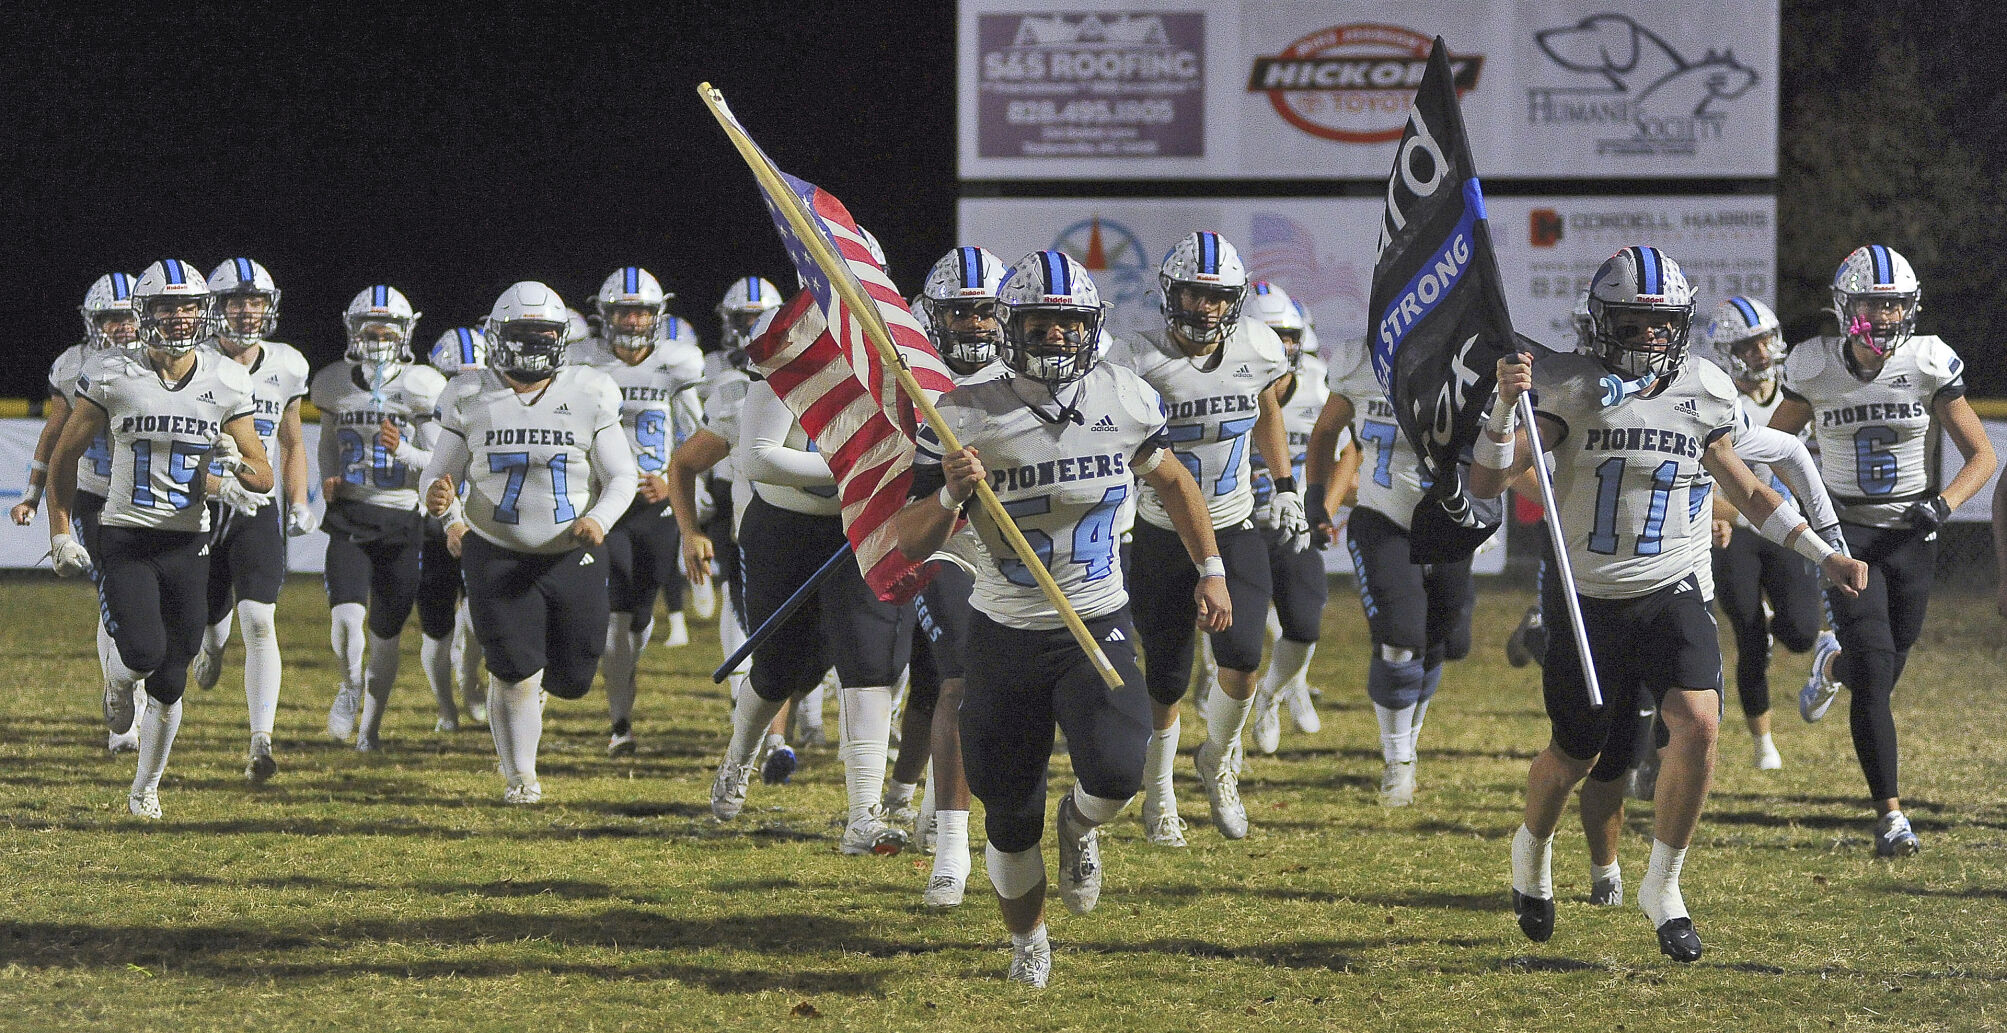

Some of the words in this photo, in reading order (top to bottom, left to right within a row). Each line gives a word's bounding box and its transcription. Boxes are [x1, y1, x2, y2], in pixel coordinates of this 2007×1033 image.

[1051, 51, 1197, 79] ROOFING
[1264, 60, 1467, 88] HICKOR
[1331, 96, 1417, 113] TOYOT
[1043, 295, 1073, 304] Riddell
[1380, 233, 1470, 356] STRONG
[1636, 296, 1665, 304] Riddell
[1673, 404, 1701, 418] adidas
[1823, 402, 1926, 428] PIONEERS
[122, 415, 219, 436] PIONEERS
[485, 427, 575, 447] PIONEERS
[1585, 426, 1698, 459] PIONEERS
[991, 452, 1124, 493] PIONEERS
[1853, 424, 1898, 495] 6
[130, 438, 214, 510] 15
[487, 450, 577, 526] 71
[1586, 456, 1680, 556] 11
[998, 484, 1129, 588] 54
